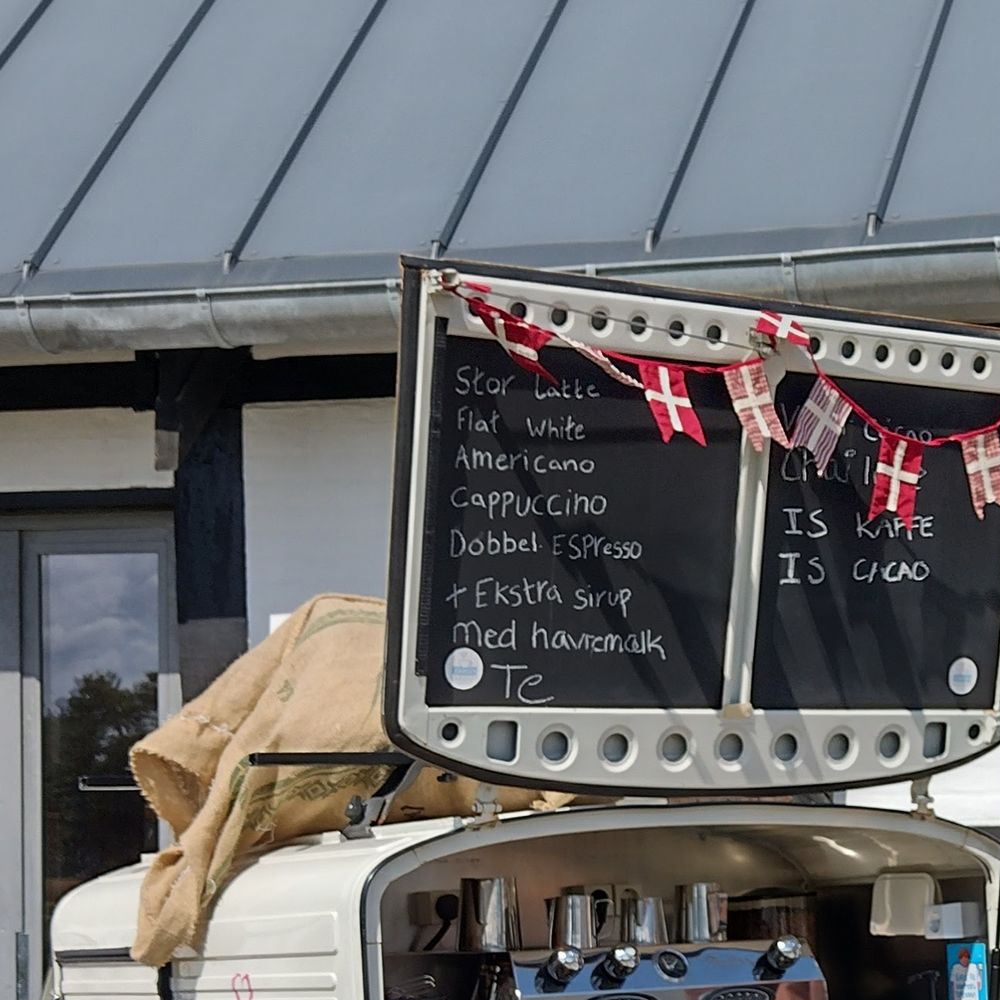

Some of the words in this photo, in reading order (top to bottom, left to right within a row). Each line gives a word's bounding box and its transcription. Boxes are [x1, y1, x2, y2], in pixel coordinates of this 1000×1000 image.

[454, 365, 516, 396] Stor
[534, 373, 600, 400] Latte
[457, 405, 500, 434] Flat
[526, 414, 586, 441] White
[454, 444, 596, 474] Americano
[450, 486, 608, 520] Cappuccino
[782, 507, 829, 539] IS
[856, 511, 935, 541] KAFFE
[778, 552, 826, 585] IS
[475, 576, 564, 609] Ekstra
[490, 664, 554, 704] Te
